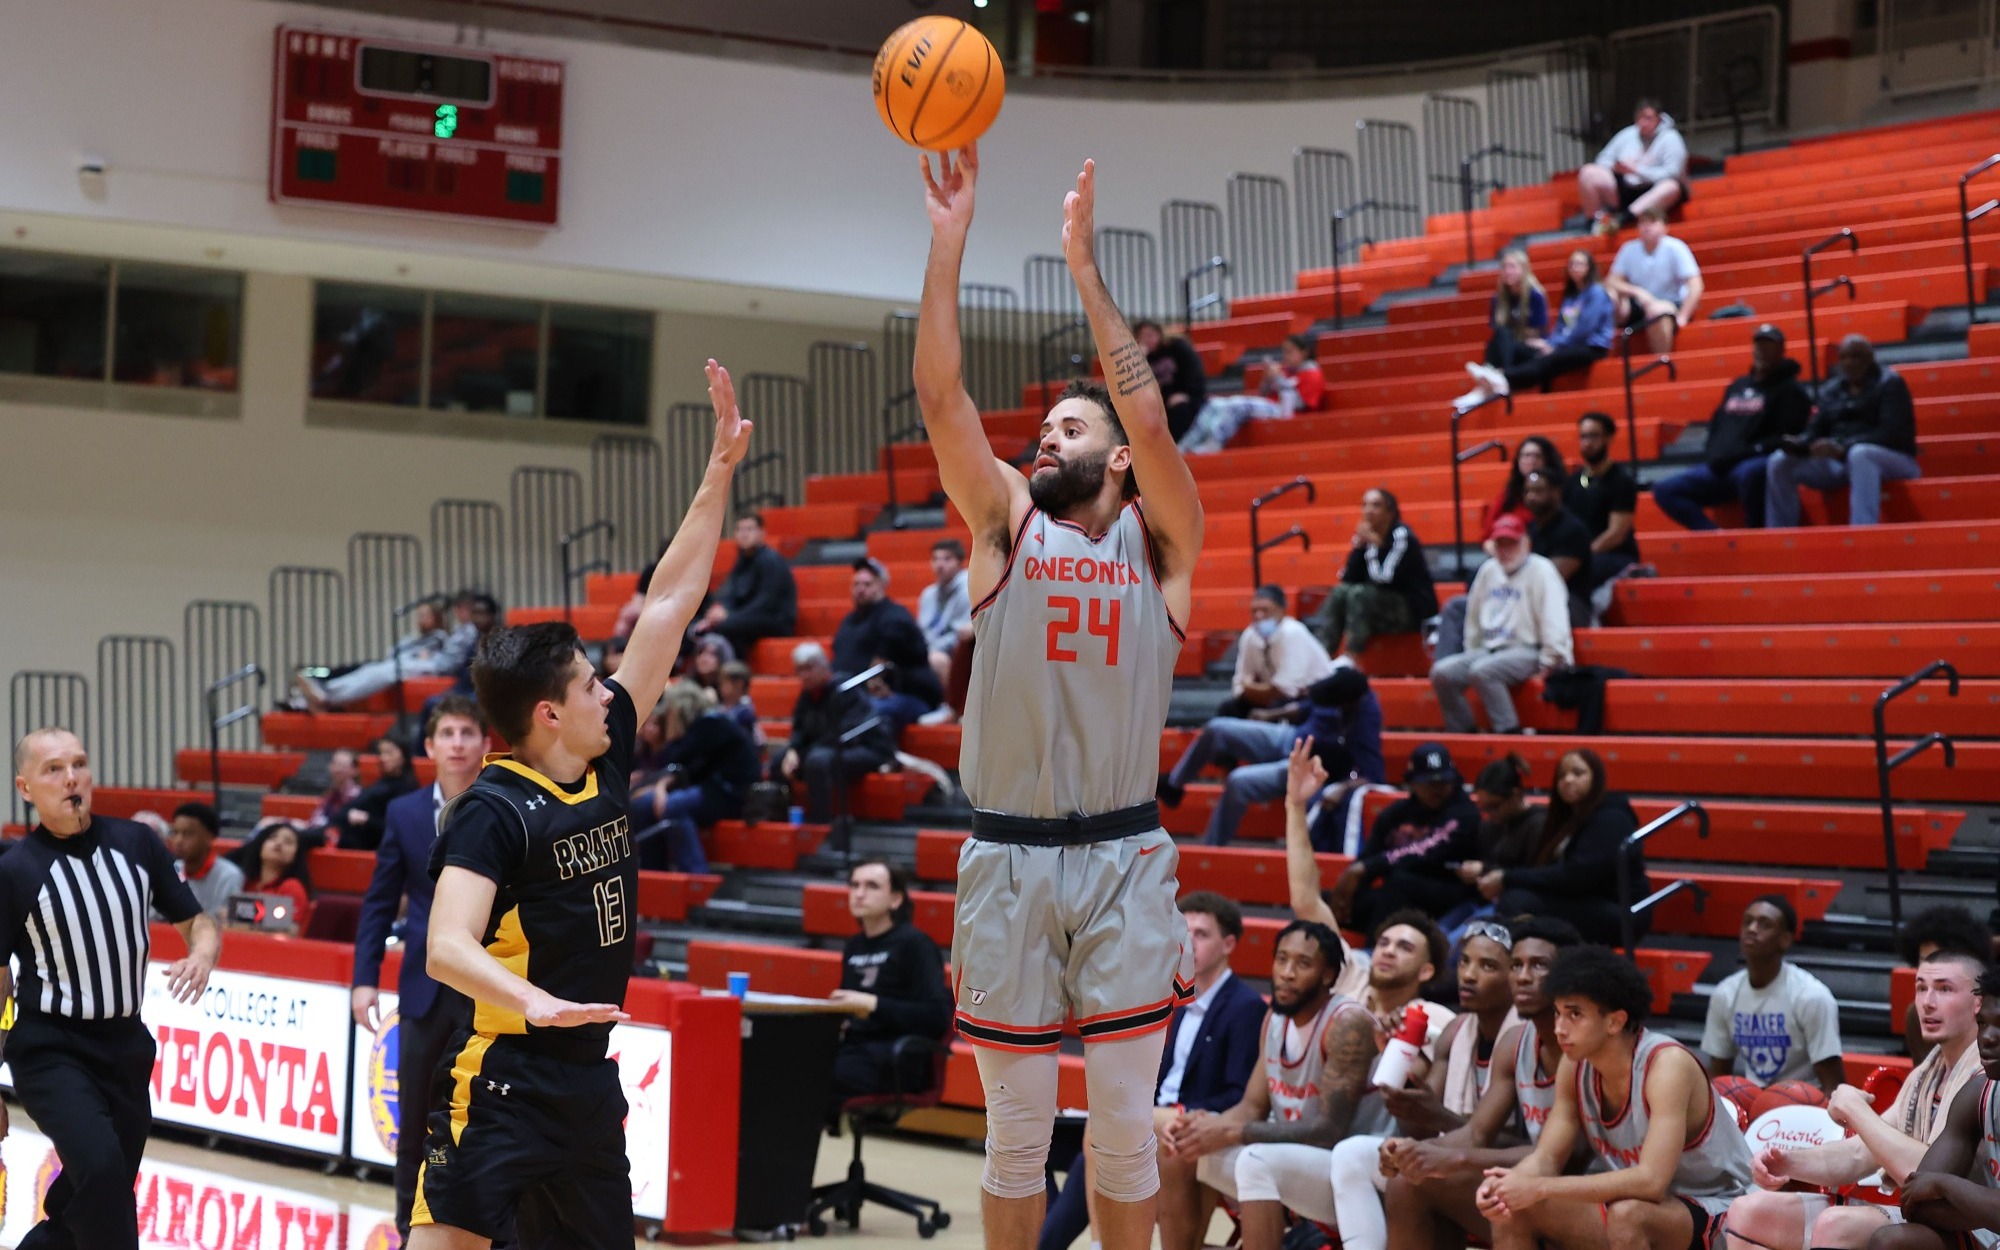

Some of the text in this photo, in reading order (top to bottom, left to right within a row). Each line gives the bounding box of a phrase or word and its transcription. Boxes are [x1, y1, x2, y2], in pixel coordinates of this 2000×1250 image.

[1046, 595, 1121, 667] 24
[553, 815, 630, 880] PRATT
[593, 875, 626, 946] 13
[204, 986, 307, 1030] COLLEGE AT
[144, 1023, 338, 1136] NEONTA
[1756, 1119, 1824, 1146] Oneonta
